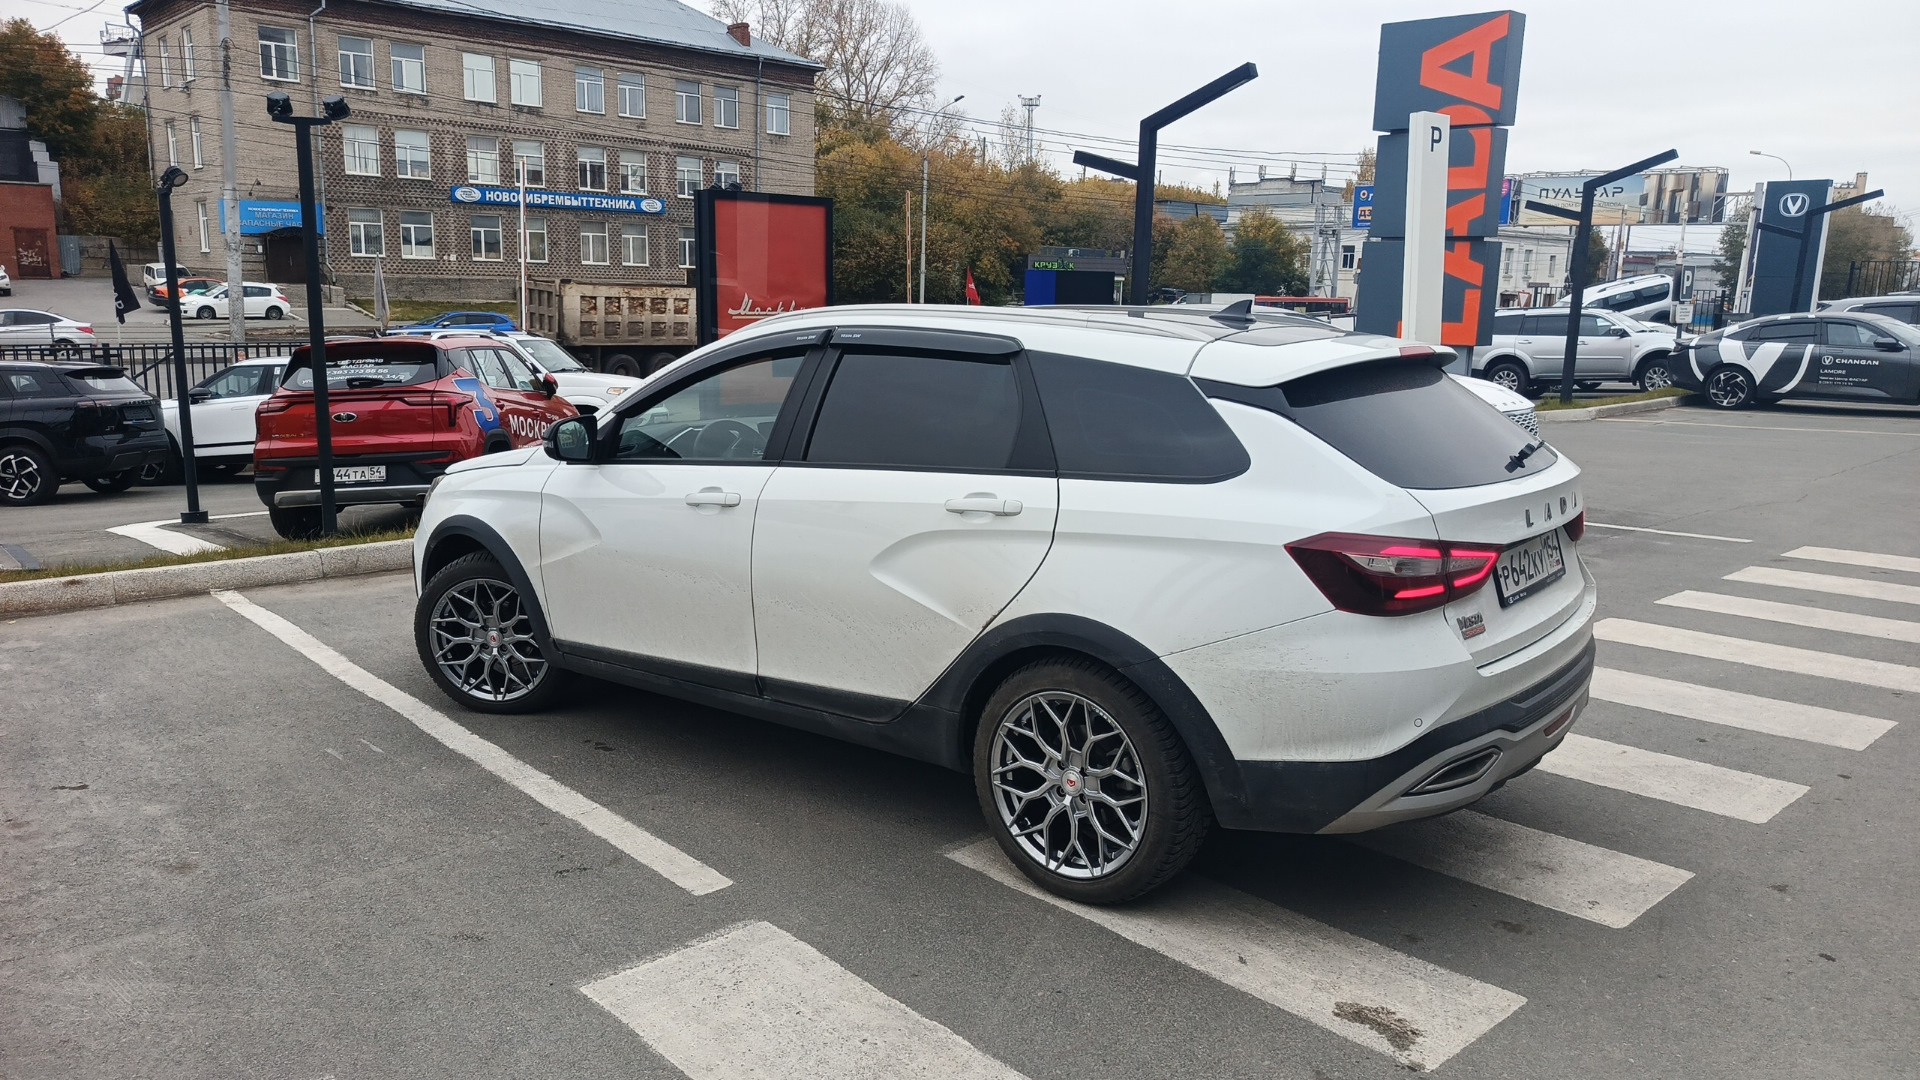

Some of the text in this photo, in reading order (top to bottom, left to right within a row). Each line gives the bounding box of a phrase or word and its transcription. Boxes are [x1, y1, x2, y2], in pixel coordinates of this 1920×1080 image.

[1396, 11, 1510, 346] LADA
[240, 219, 284, 228] АПАСНЫЕ
[1683, 270, 1693, 295] P
[728, 292, 806, 316] Москв
[1835, 358, 1879, 366] CHANGAN
[508, 414, 550, 439] МОСКВ
[335, 466, 382, 480] 44ТА 54
[1525, 491, 1577, 528] LADA
[1501, 548, 1545, 591] Р642КУ
[1542, 533, 1559, 559] 154
